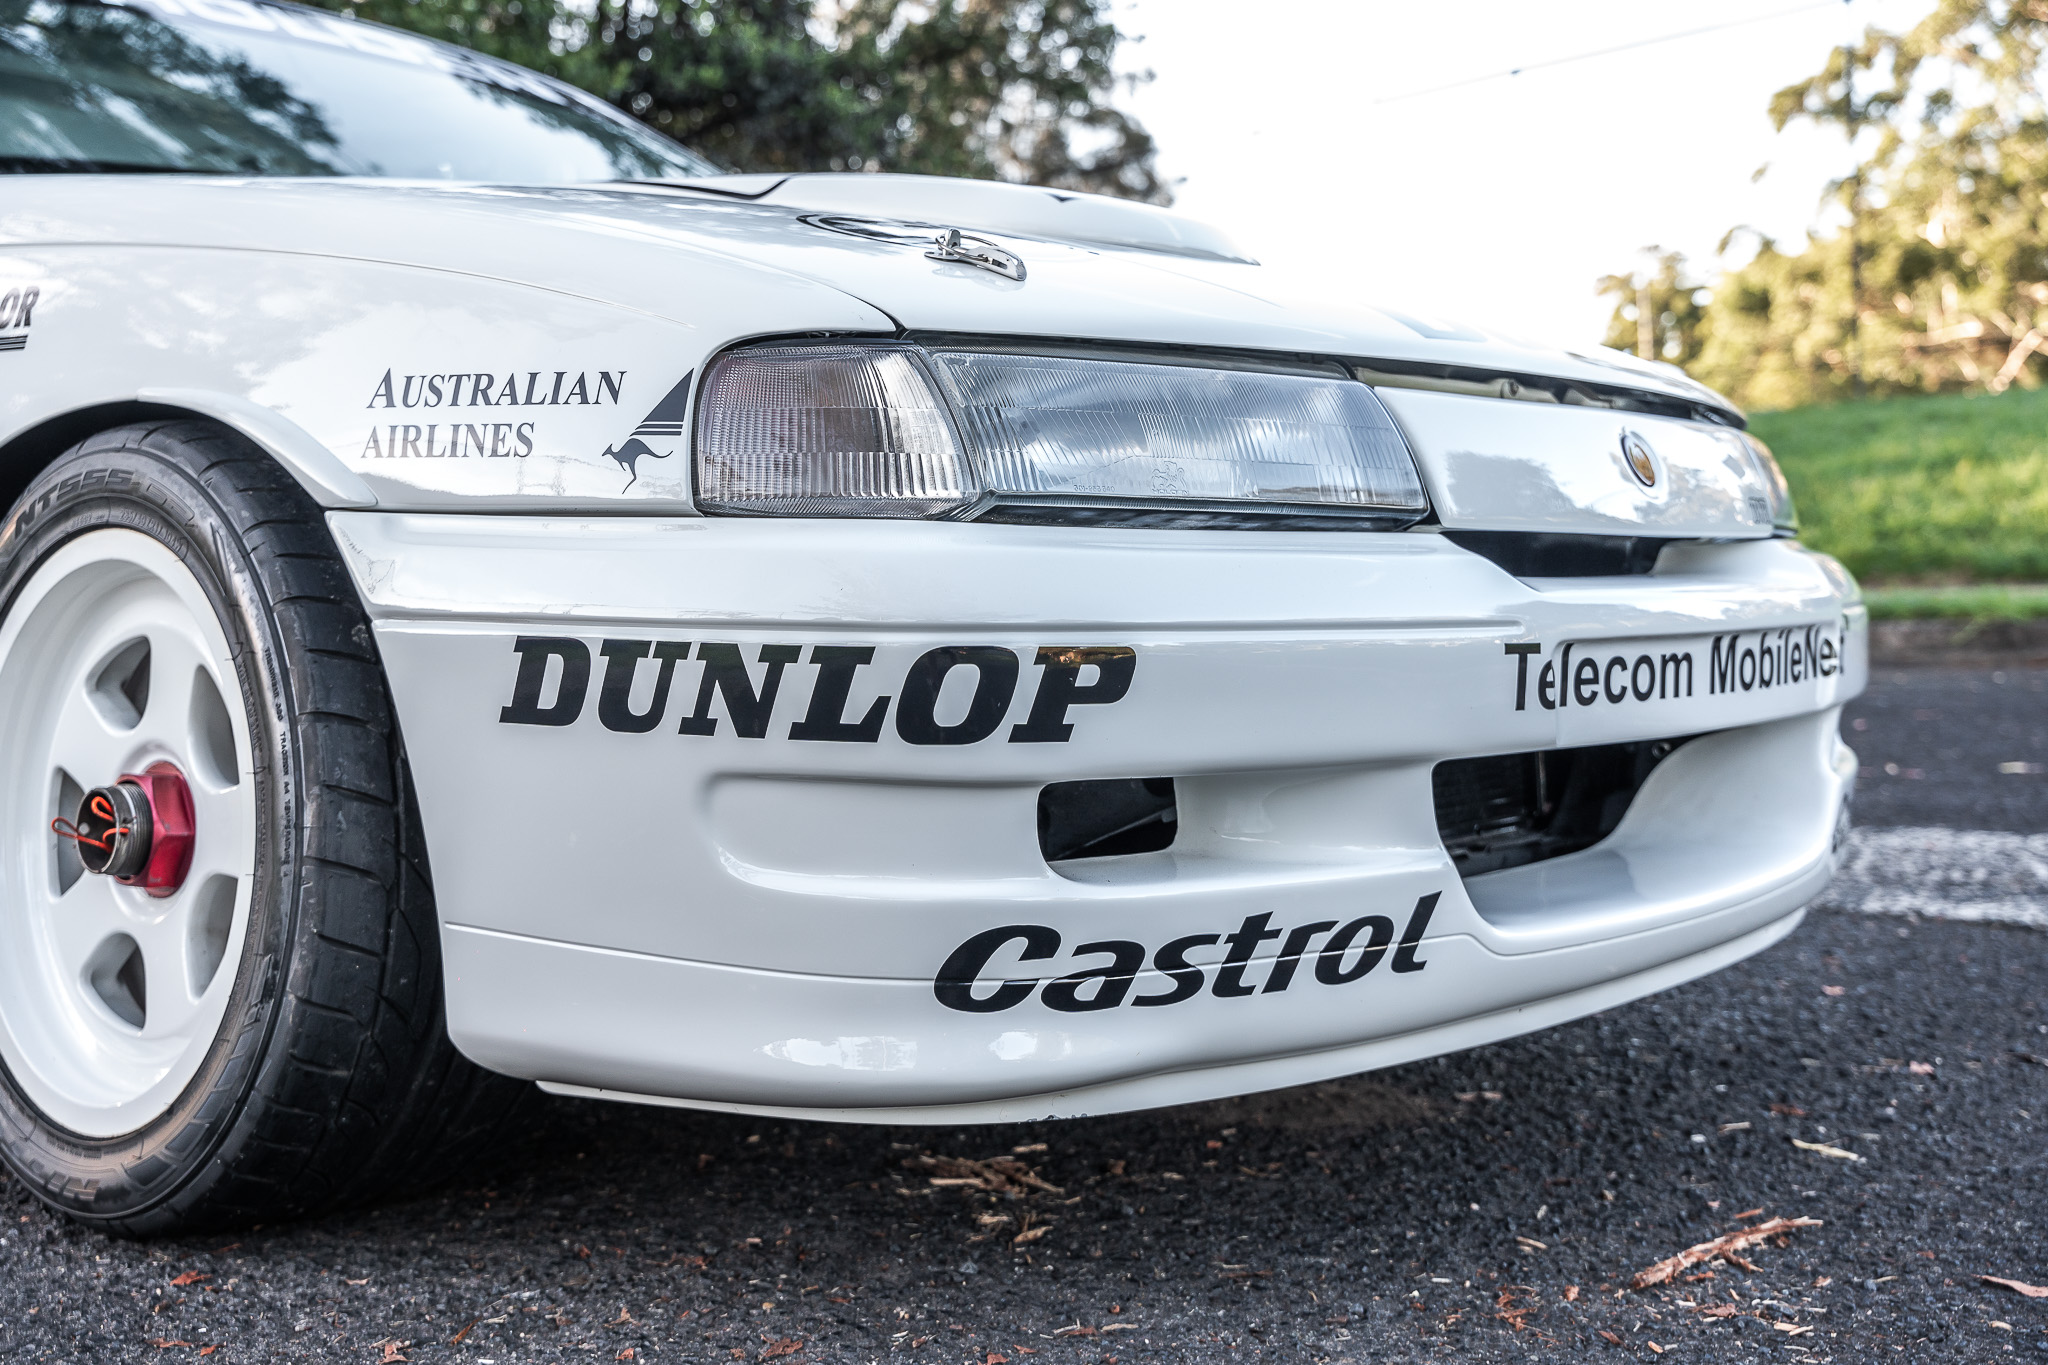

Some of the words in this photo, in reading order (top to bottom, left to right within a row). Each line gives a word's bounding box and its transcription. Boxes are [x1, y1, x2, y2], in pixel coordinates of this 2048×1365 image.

[366, 367, 628, 409] AUSTRALIAN
[361, 422, 535, 459] AIRLINES
[15, 468, 134, 538] NT555
[499, 635, 1137, 746] DUNLOP
[1504, 641, 1693, 711] Telecom
[933, 890, 1443, 1014] Castrol
